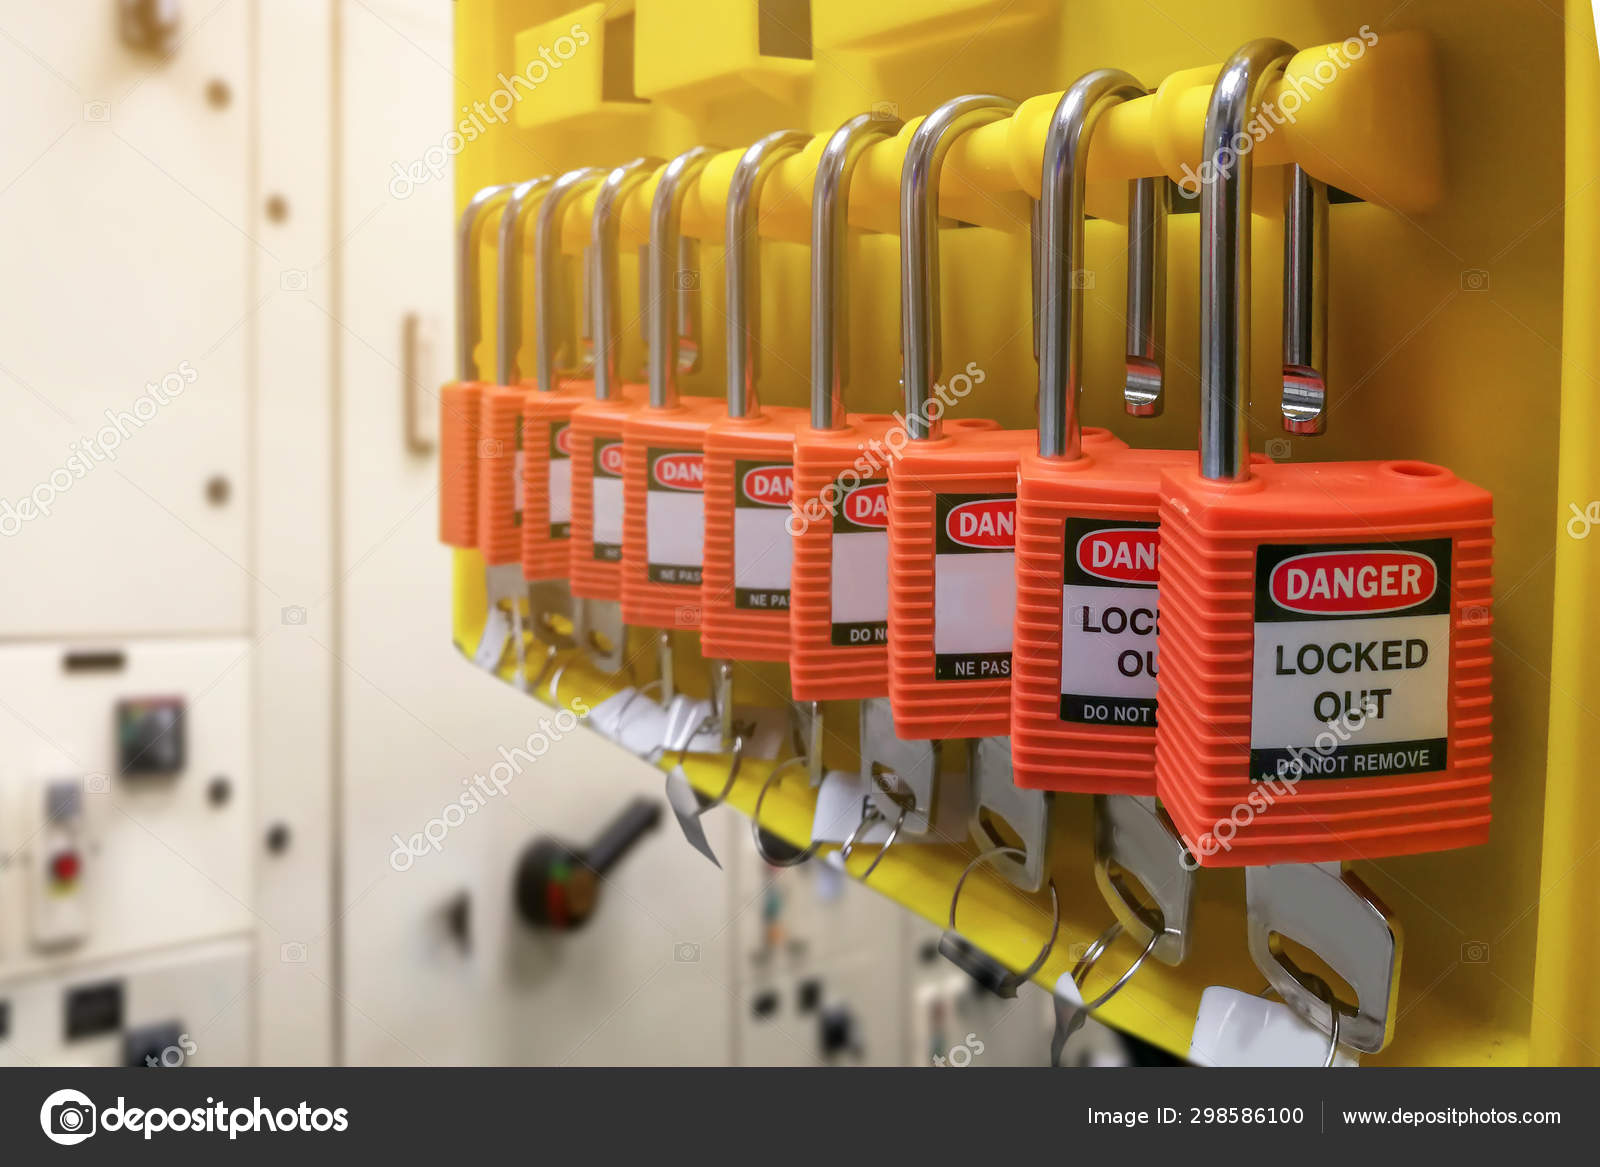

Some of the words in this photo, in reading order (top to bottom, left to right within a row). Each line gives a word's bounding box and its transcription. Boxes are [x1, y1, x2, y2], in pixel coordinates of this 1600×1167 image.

[959, 511, 1014, 538] DAN
[1092, 539, 1160, 571] DAN
[1286, 563, 1422, 601] DANGER
[750, 593, 767, 606] NE
[1082, 605, 1160, 636] LOC
[850, 628, 871, 642] DO
[955, 660, 976, 676] NE
[981, 659, 1010, 675] PAS
[1275, 638, 1429, 676] LOCKED
[1083, 704, 1108, 720] DO
[1114, 706, 1150, 723] NOT
[1313, 688, 1392, 723] OUT
[1276, 755, 1304, 777] DO
[1309, 754, 1349, 775] NOT
[1354, 749, 1430, 773] REMOVE
